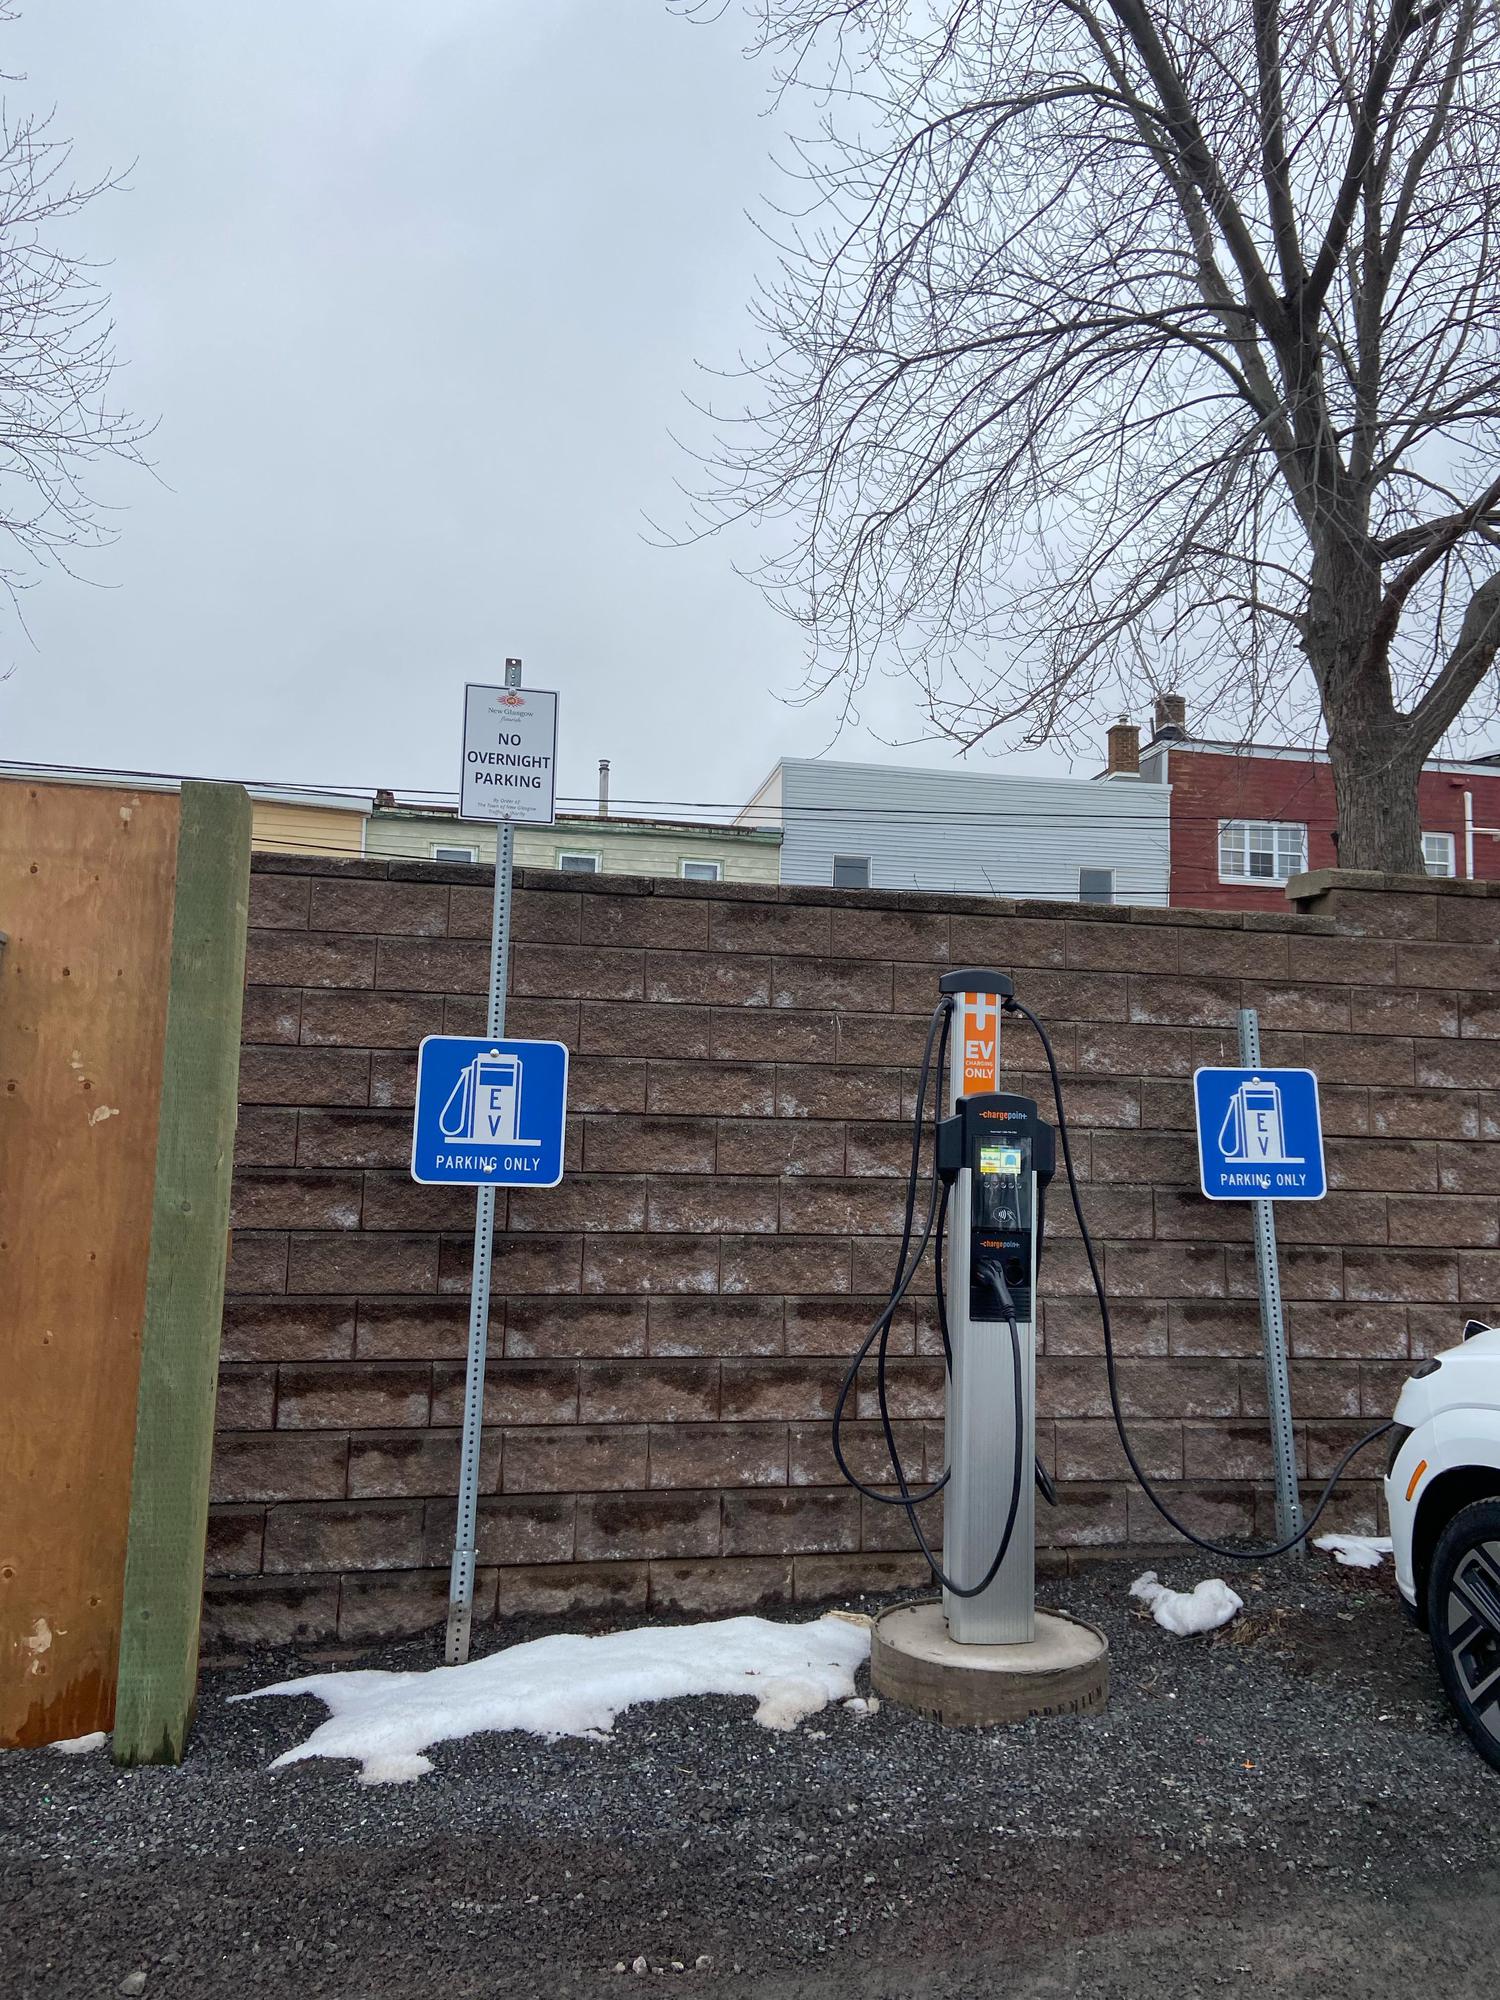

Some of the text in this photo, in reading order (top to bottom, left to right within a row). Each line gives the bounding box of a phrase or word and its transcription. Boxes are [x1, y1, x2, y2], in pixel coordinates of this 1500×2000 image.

[498, 733, 521, 746] NO
[467, 751, 551, 769] OVERNIGHT
[475, 772, 541, 788] PARKING
[965, 1040, 994, 1059] EV
[965, 1067, 994, 1078] ONLY
[436, 1155, 540, 1171] PARKING ONLY
[1220, 1173, 1306, 1186] PARKING ONLY
